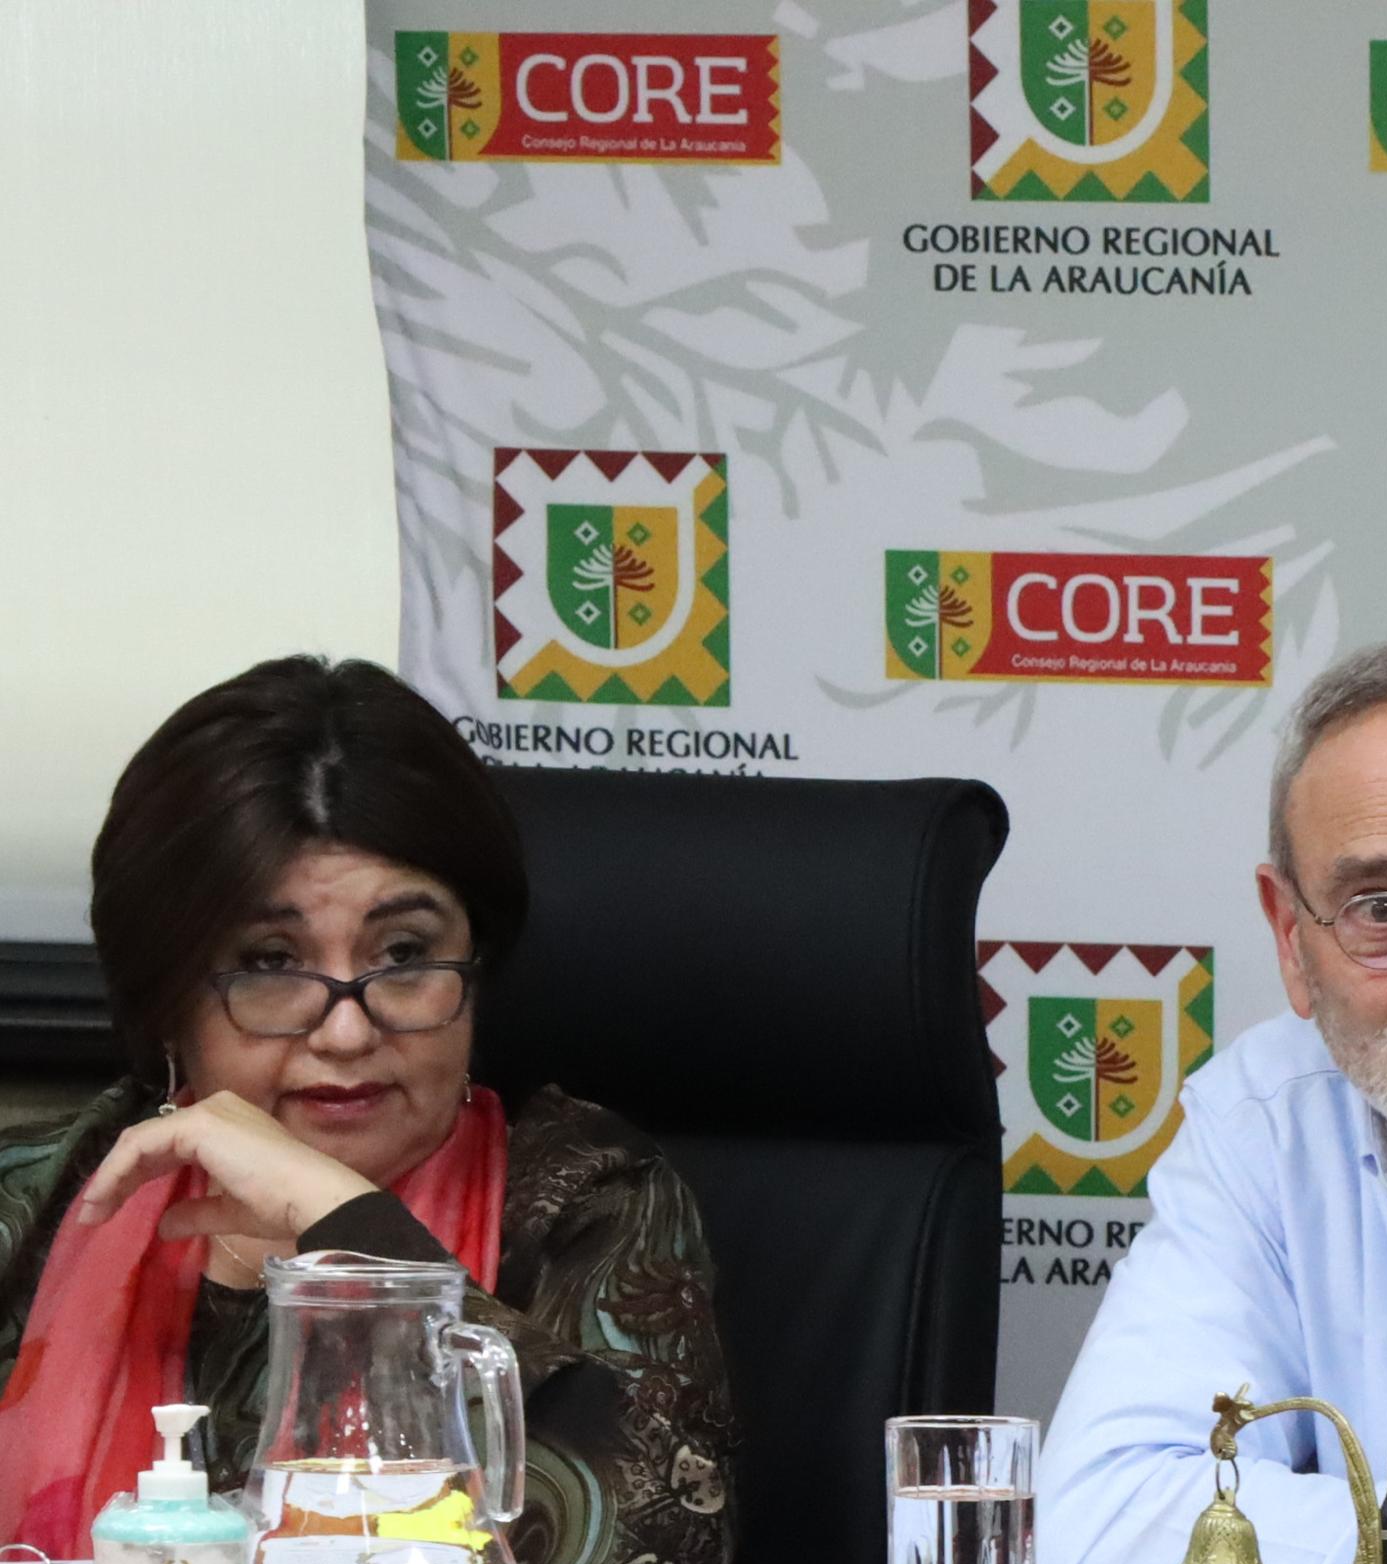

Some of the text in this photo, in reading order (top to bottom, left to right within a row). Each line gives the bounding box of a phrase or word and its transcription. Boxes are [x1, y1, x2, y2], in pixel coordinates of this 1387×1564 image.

[515, 53, 749, 125] CORE
[521, 133, 577, 152] Consejo
[578, 135, 639, 153] Regional
[639, 138, 658, 151] de
[659, 137, 678, 152] La
[902, 223, 1280, 258] GOBIERNO REGIONAL
[933, 259, 1252, 296] DE LA ARAUCANÍA
[1006, 572, 1240, 646] CORE
[1011, 653, 1067, 671] Consejo
[1068, 654, 1128, 673] Regional
[1129, 657, 1149, 672] de
[1149, 658, 1168, 673] La
[626, 728, 800, 761] REGIONAL
